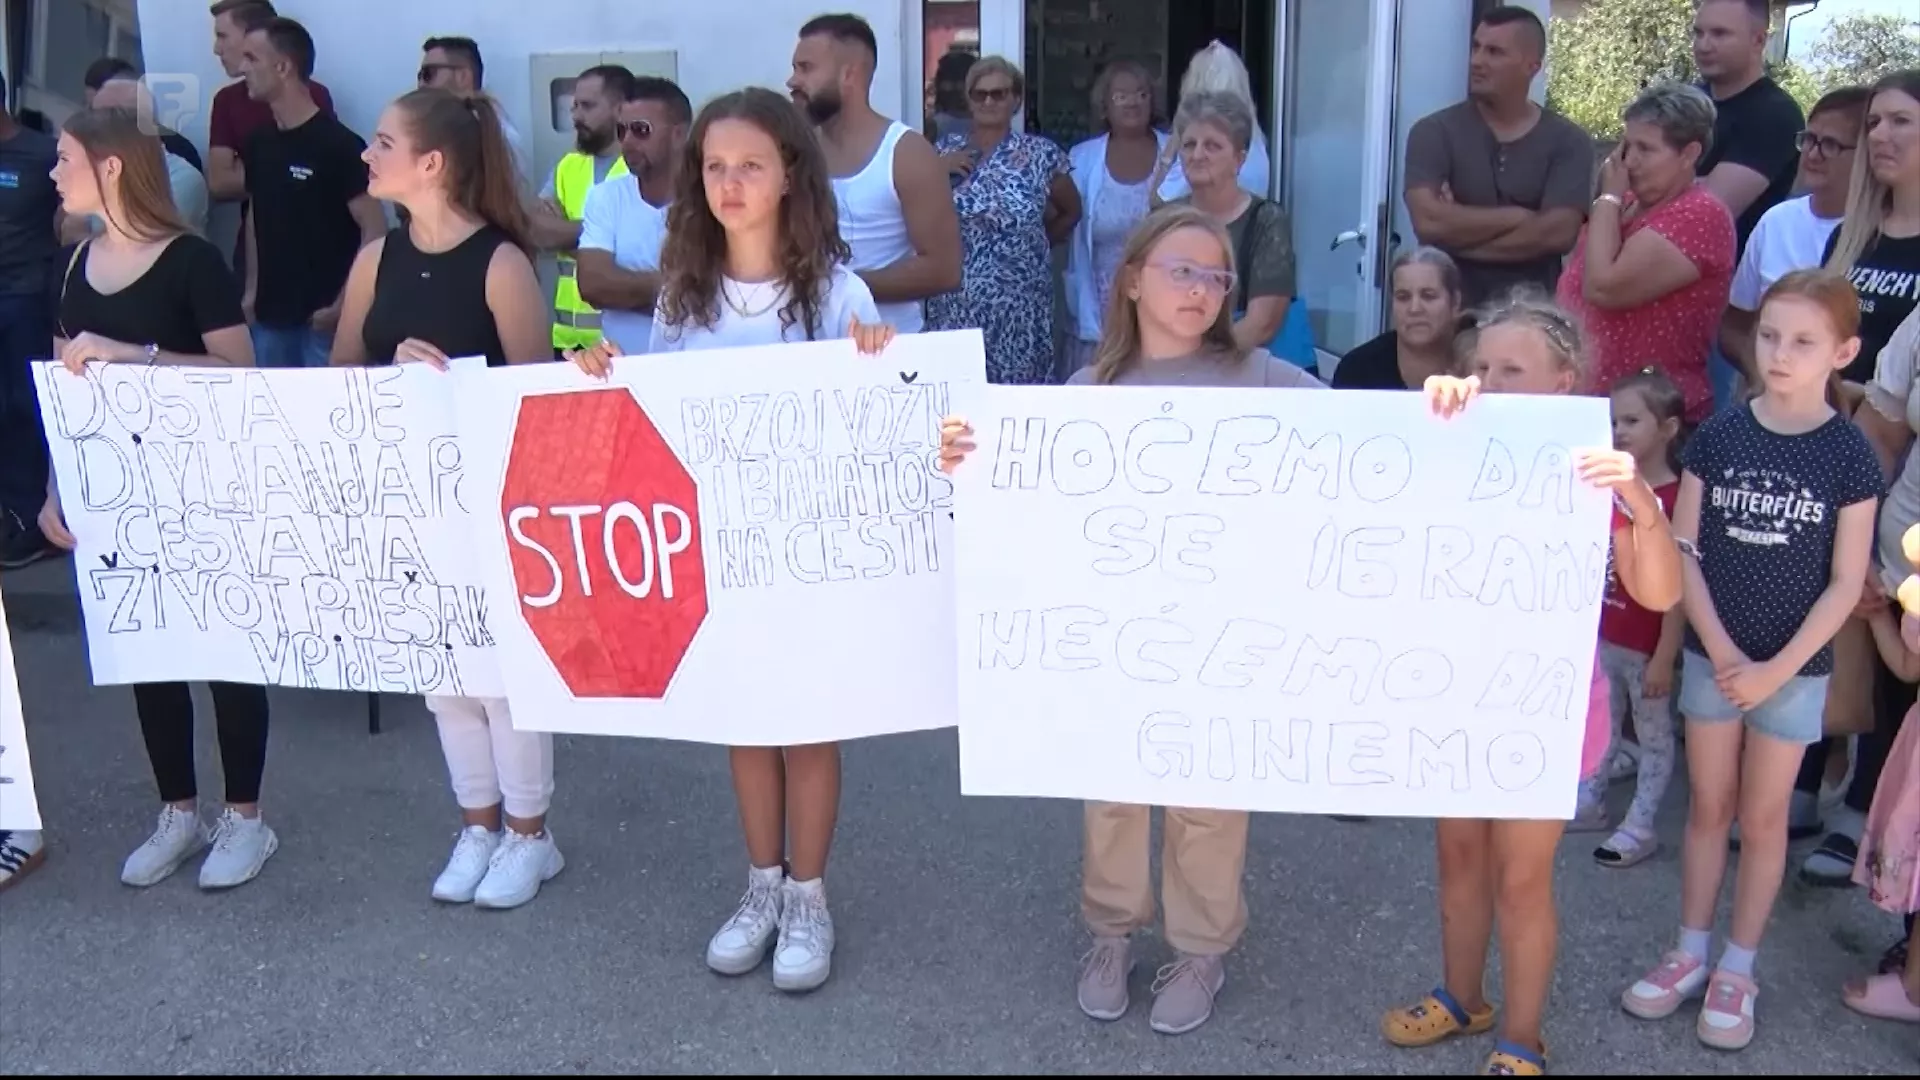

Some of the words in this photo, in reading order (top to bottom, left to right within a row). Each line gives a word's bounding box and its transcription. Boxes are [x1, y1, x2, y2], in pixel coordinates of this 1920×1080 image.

[45, 363, 299, 441] DOSTA
[330, 367, 406, 442] JE
[681, 389, 824, 463] BRZOJ
[712, 464, 729, 526] I
[1470, 437, 1574, 514] DA
[1712, 485, 1825, 523] BUTTERFLIES
[116, 504, 438, 587] CESTAMA
[508, 501, 693, 608] STOP
[716, 525, 774, 589] NA
[785, 512, 940, 584] CESTI
[1083, 505, 1226, 584] SE
[90, 551, 290, 637] ŽIVOT
[248, 633, 466, 696] VRIJEDI
[977, 603, 1454, 705] NEĆEMO
[1475, 651, 1578, 720] DA
[1137, 710, 1546, 792] GINEMO
